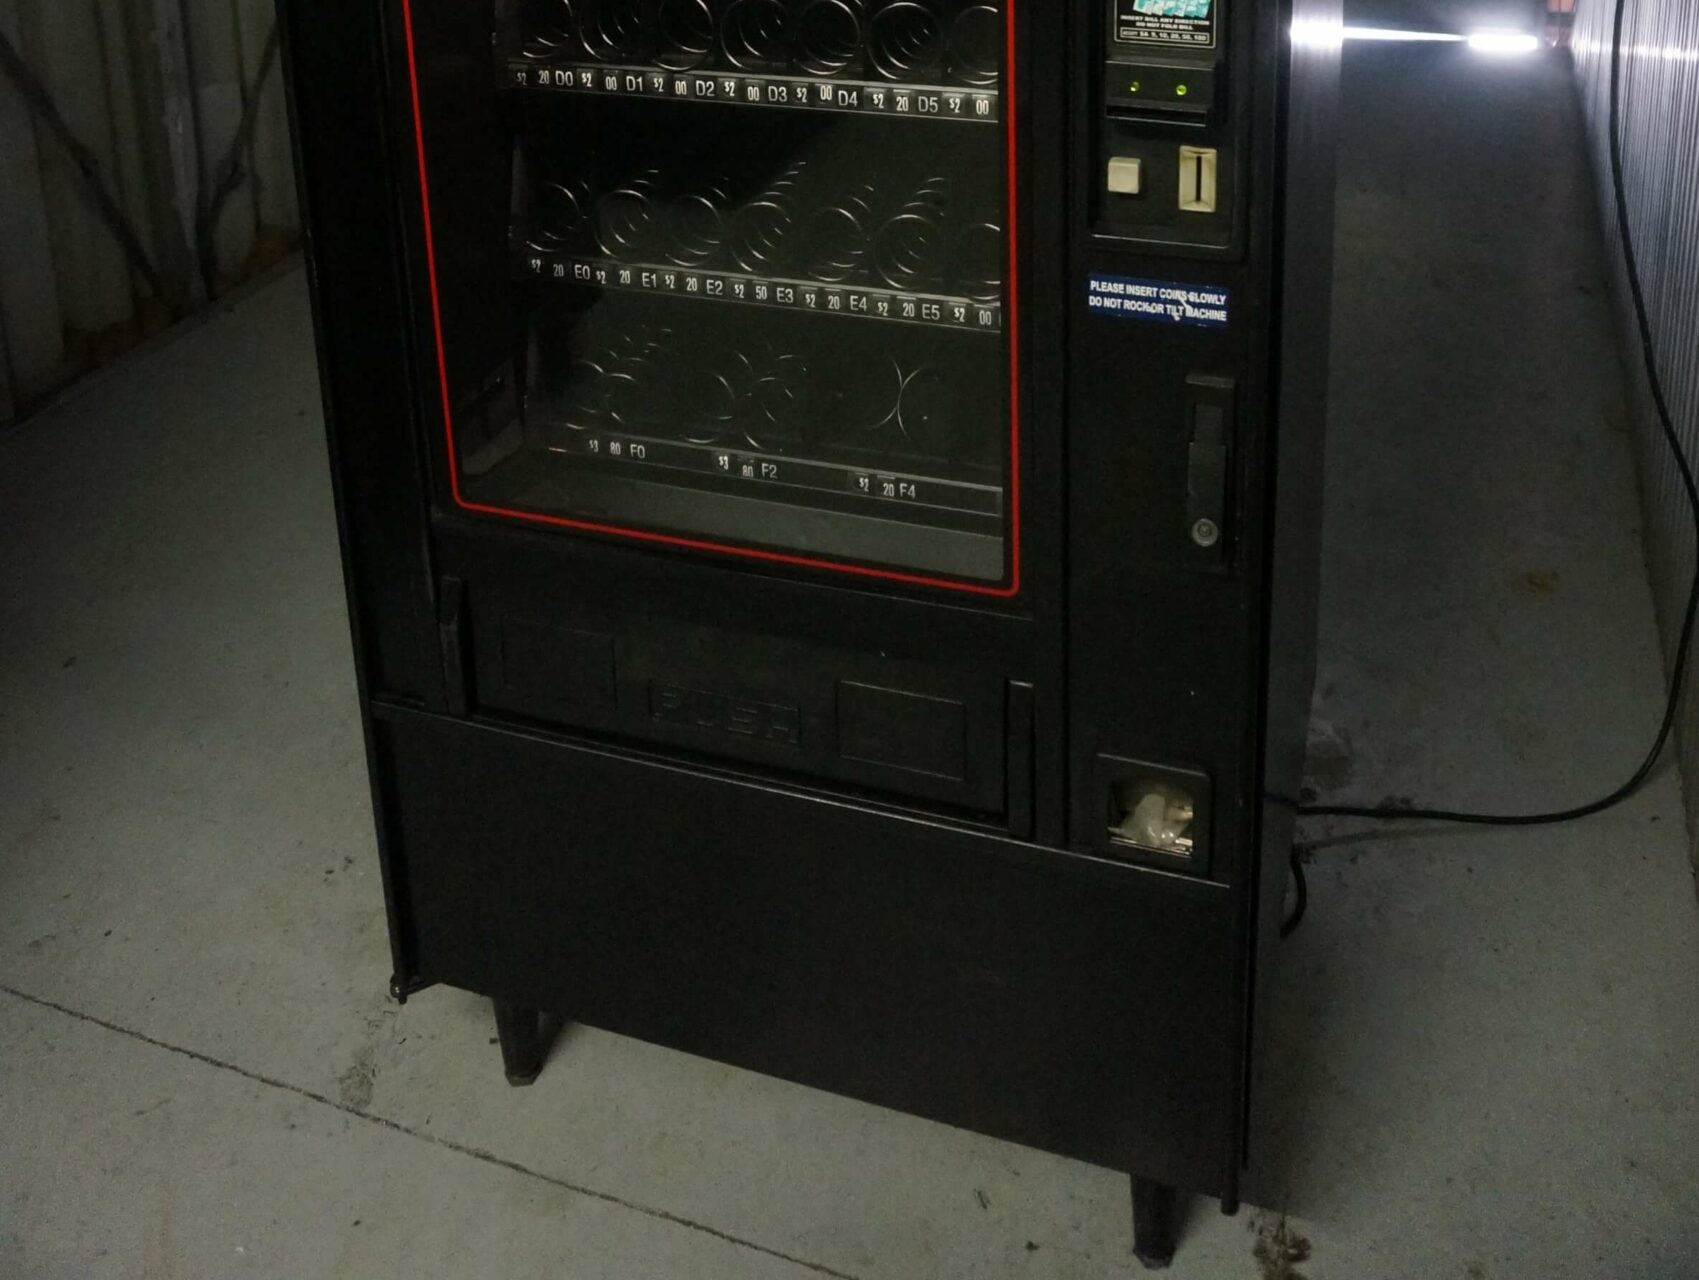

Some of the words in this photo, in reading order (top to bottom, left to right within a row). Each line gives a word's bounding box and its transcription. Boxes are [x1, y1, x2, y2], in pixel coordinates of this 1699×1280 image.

[517, 72, 527, 85] $2
[539, 71, 549, 84] 20
[556, 71, 573, 86] D0
[582, 73, 591, 87] $2
[606, 77, 617, 90] 00
[626, 76, 642, 91] D1
[654, 78, 663, 91] $2
[675, 81, 687, 94] 00
[696, 80, 715, 96] D2
[725, 82, 734, 96] $2
[748, 86, 759, 100] 00
[769, 86, 787, 101] D3
[797, 88, 807, 102] $2
[820, 86, 832, 100] 00
[838, 91, 857, 106] D4
[873, 93, 884, 108] $2
[896, 97, 908, 111] 20
[918, 96, 938, 112] D5
[950, 98, 960, 112] $2
[976, 100, 989, 115] 00
[532, 260, 541, 272] $2
[553, 264, 563, 277] 20
[575, 264, 590, 279] E0
[596, 271, 606, 284] $2
[620, 270, 630, 283] 20
[642, 273, 656, 287] E1
[665, 275, 675, 288] $2
[686, 277, 697, 291] 20
[706, 280, 722, 295] E2
[735, 284, 744, 298] $2
[756, 286, 767, 299] 50
[777, 288, 793, 303] E3
[1090, 280, 1125, 295] PLEASE
[1126, 284, 1158, 298] INSERT
[1160, 288, 1187, 301] COINS
[1189, 291, 1226, 305] SLOWLY
[805, 294, 815, 307] $2
[828, 295, 839, 309] 20
[850, 295, 867, 311] E4
[878, 302, 888, 316] $2
[903, 303, 914, 317] 20
[922, 304, 939, 320] E5
[1089, 296, 1102, 307] DO
[1104, 298, 1122, 309] NOT
[1123, 300, 1148, 312] ROCK
[1150, 303, 1165, 314] OR
[1166, 305, 1184, 317] TILT
[1185, 307, 1227, 321] MACHINE
[954, 308, 965, 322] $2
[979, 310, 991, 325] 00
[610, 442, 621, 455] 80
[630, 444, 645, 458] F0
[762, 463, 778, 479] F2
[883, 483, 894, 496] 20
[900, 483, 916, 498] F4
